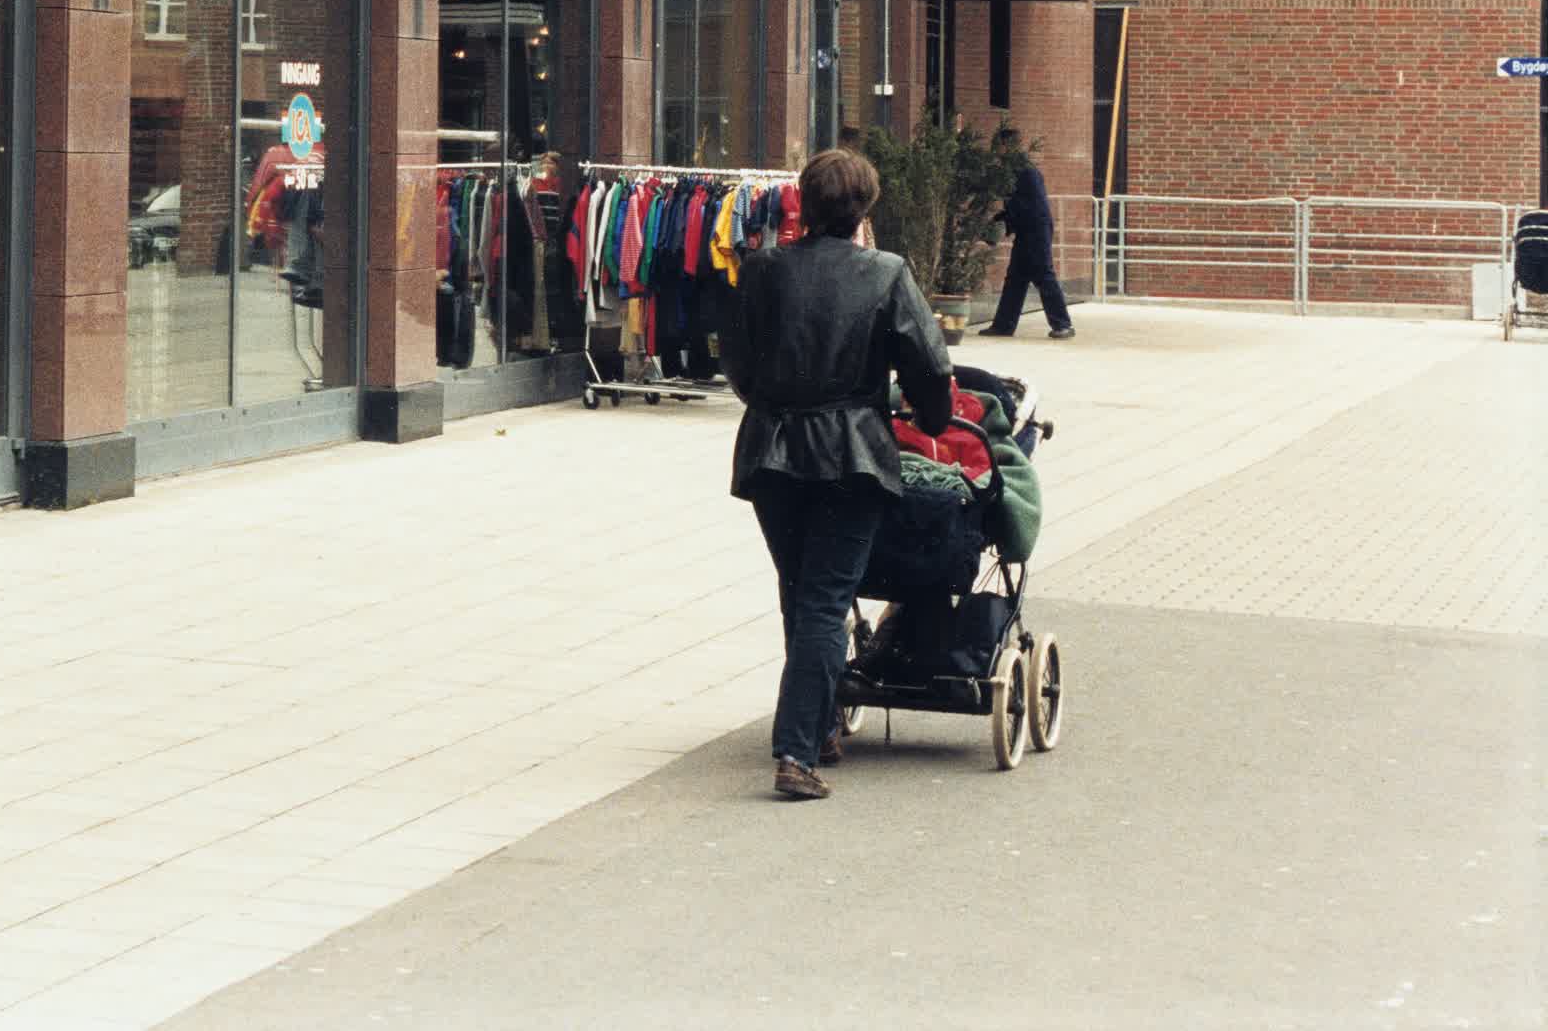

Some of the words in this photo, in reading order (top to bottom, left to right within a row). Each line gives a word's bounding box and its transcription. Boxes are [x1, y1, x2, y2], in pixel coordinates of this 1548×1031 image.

[280, 61, 320, 85] INNGANG
[1512, 60, 1548, 75] Bygdø
[291, 108, 312, 144] ICA
[295, 168, 307, 190] 50
